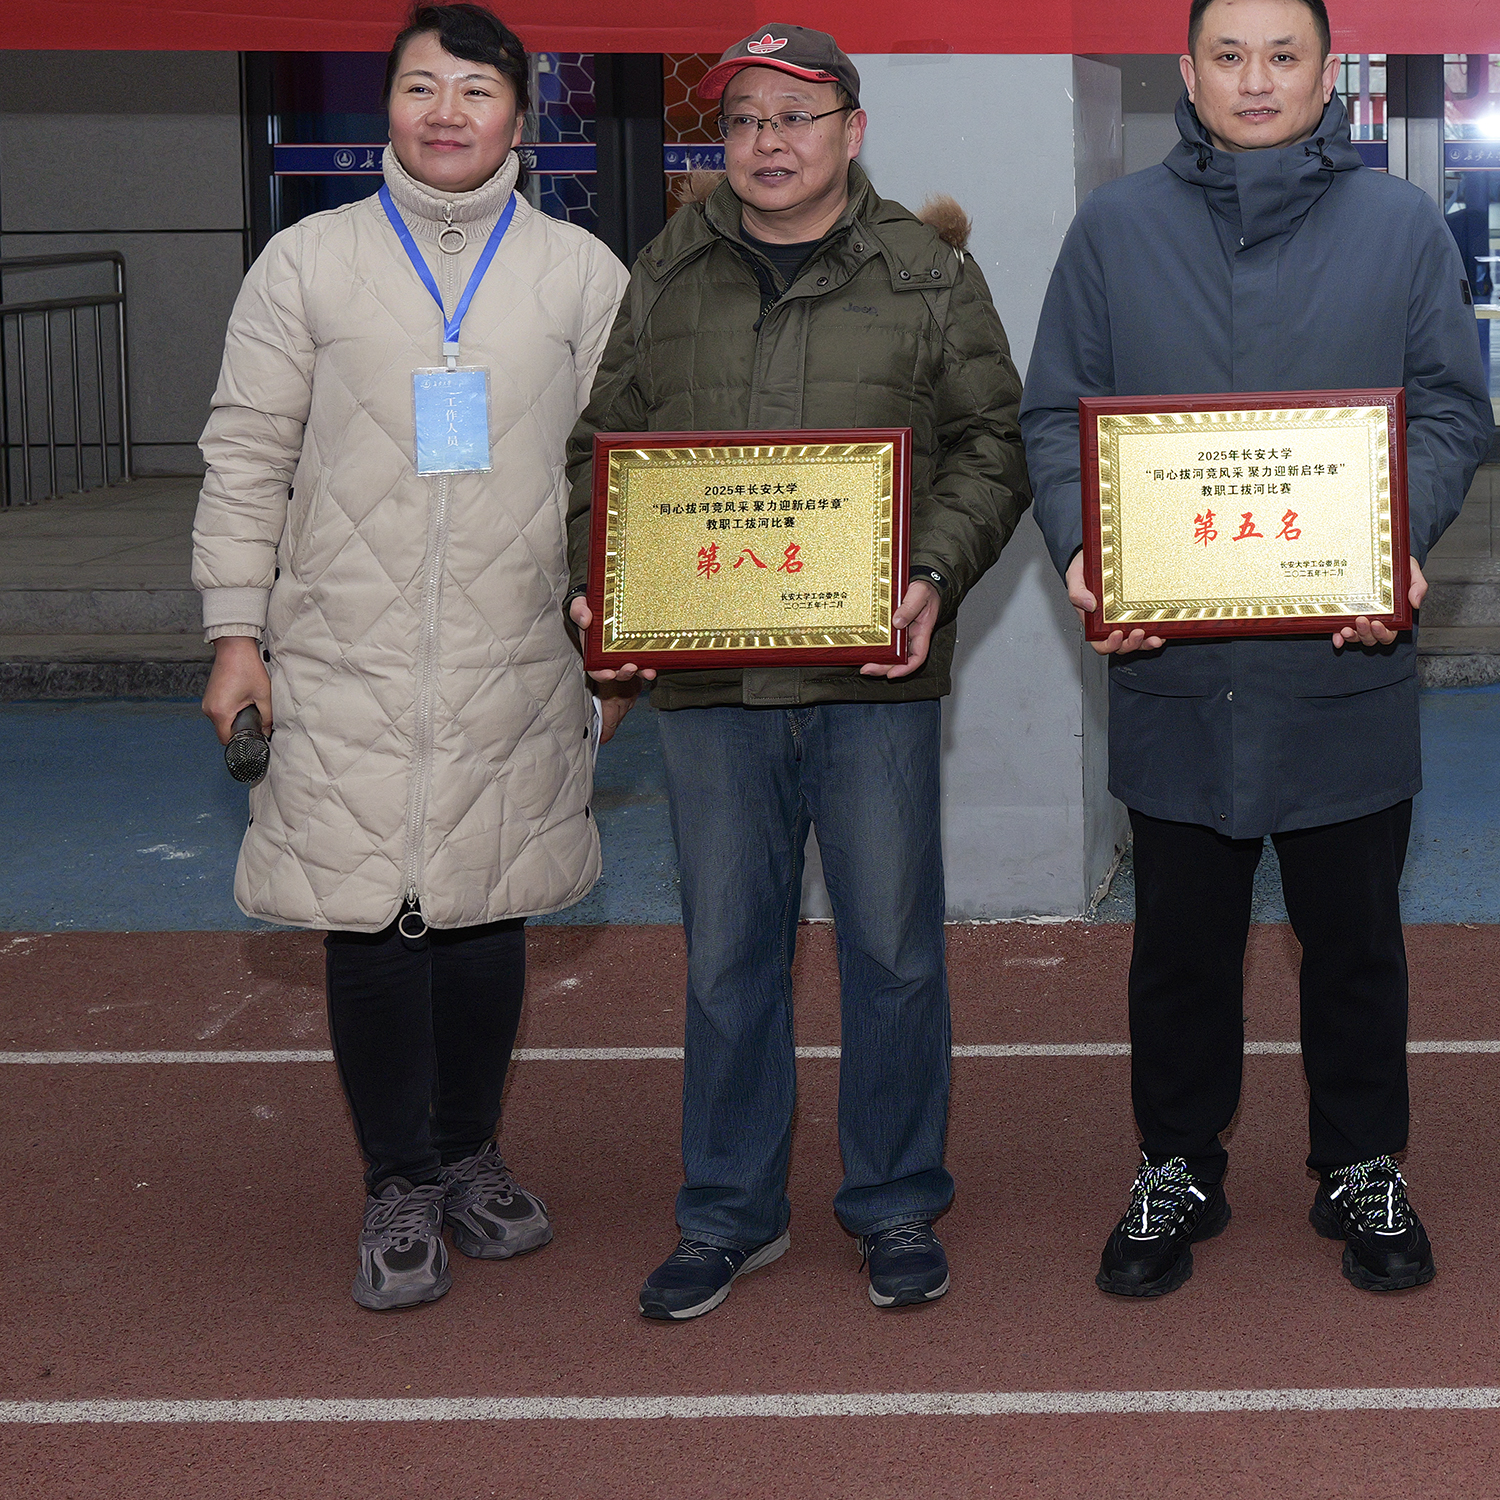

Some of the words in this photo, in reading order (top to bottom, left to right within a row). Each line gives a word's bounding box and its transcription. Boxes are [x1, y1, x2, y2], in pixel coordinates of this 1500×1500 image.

[444, 397, 459, 447] 工作人员
[1197, 447, 1292, 462] 2025年长安大学
[704, 482, 798, 496] 2025年长安大学
[1201, 482, 1292, 496] 教职工拔河比赛
[706, 516, 796, 530] 教职工拔河比赛
[1193, 508, 1302, 547] 第五名
[696, 542, 804, 579] 第八名
